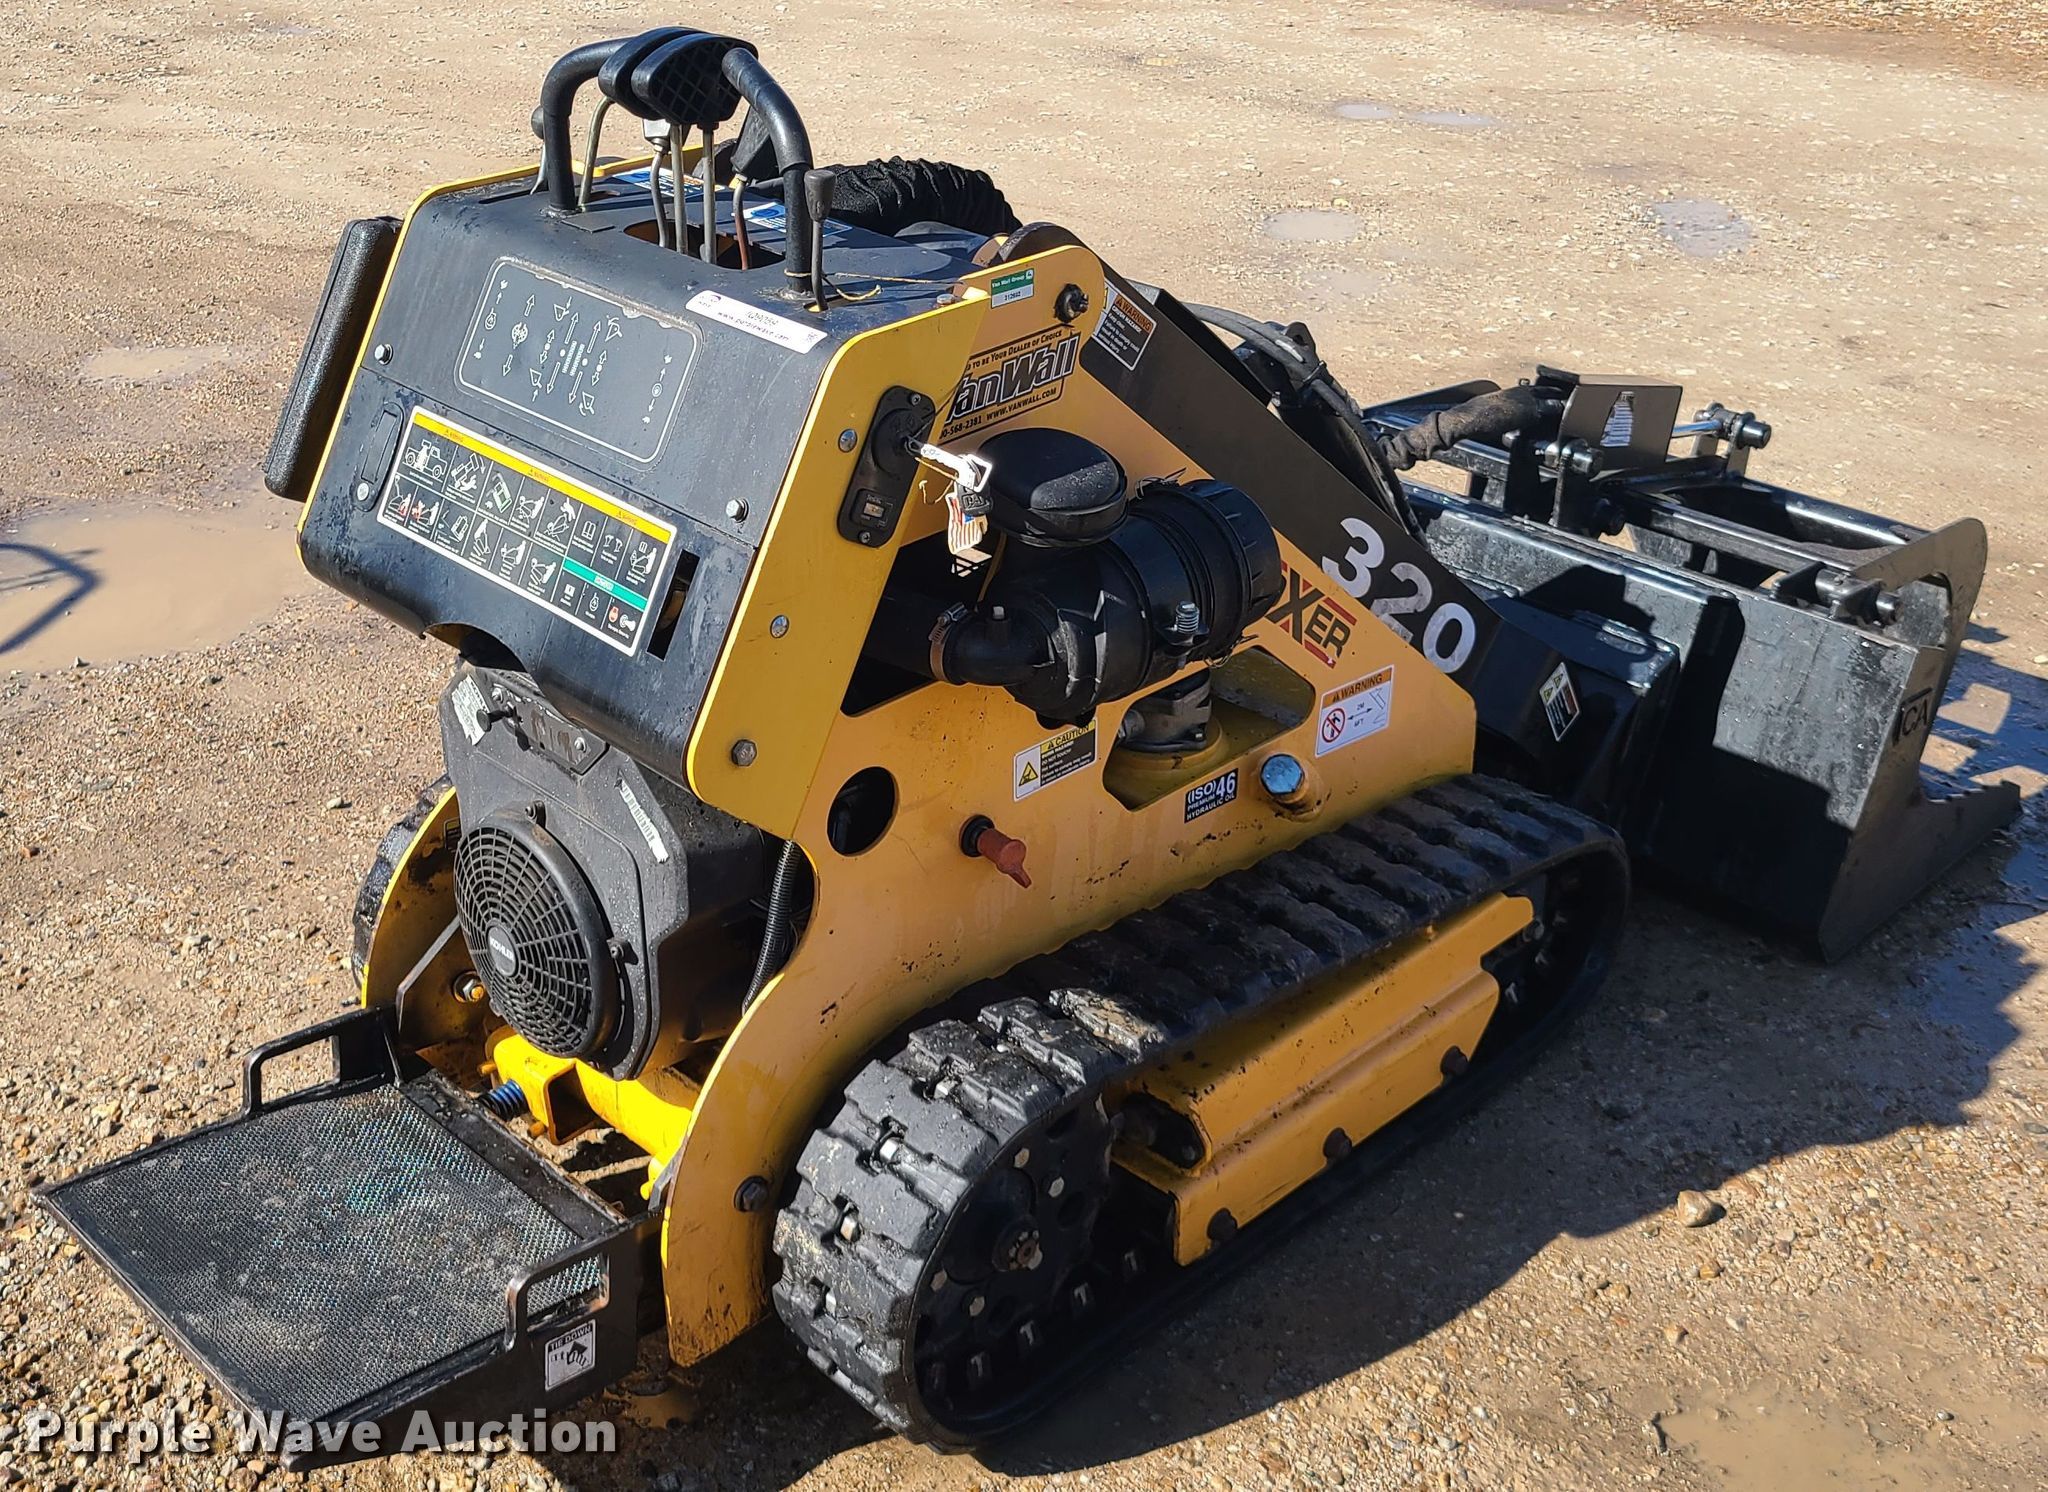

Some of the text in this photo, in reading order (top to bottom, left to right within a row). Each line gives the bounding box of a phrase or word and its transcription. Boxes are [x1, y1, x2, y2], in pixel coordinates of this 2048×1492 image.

[1121, 301, 1151, 330] WARNING
[1008, 342, 1031, 356] DEALER
[1041, 330, 1062, 344] CHOICE
[987, 387, 1057, 421] WWW.VANWALL.COM
[1321, 517, 1476, 674] 320
[1263, 571, 1352, 658] XER
[1341, 673, 1383, 698] WARNING
[1056, 725, 1088, 745] CAUTION
[1187, 771, 1236, 804] (ISO) 46
[1187, 794, 1215, 812] PREMIUM
[1187, 792, 1235, 821] HYDRAULIC OIL
[489, 936, 515, 962] KOHLER
[551, 1324, 591, 1351] TIE DOWN
